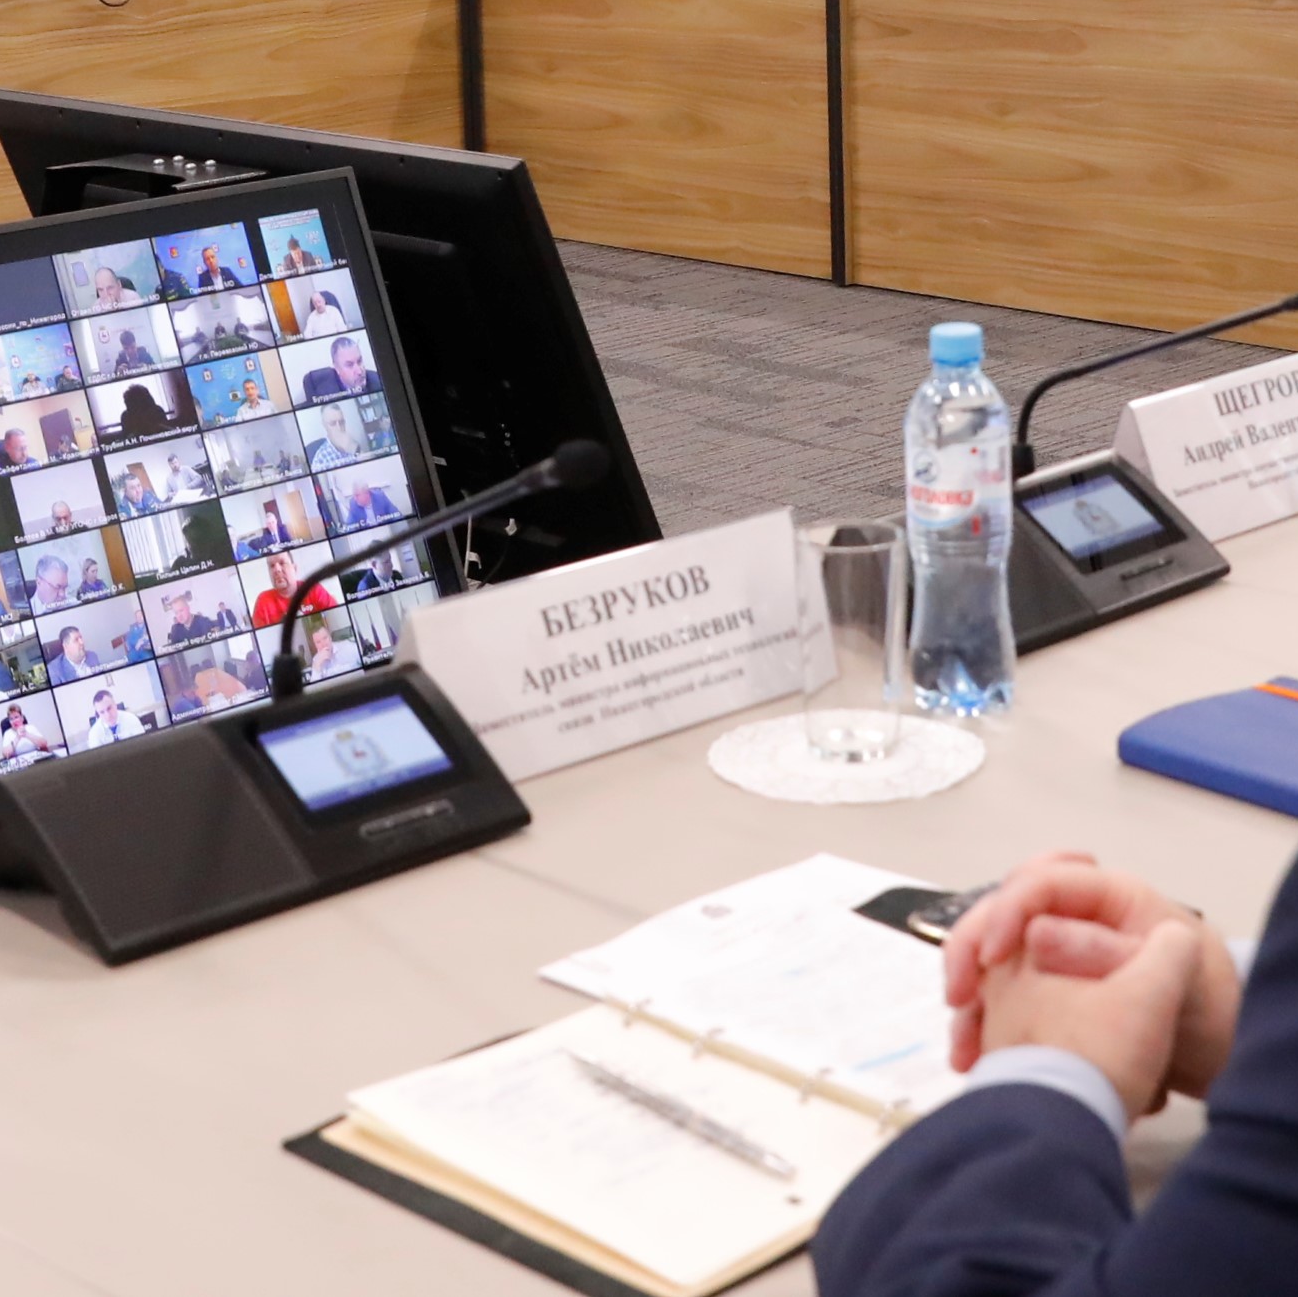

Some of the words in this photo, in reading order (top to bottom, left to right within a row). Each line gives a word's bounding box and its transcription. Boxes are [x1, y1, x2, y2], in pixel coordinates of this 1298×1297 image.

[1183, 429, 1245, 467] Андрей
[539, 564, 713, 639] БЕЗРУКОВ
[521, 652, 602, 696] Артём
[605, 606, 756, 668] Николаевич
